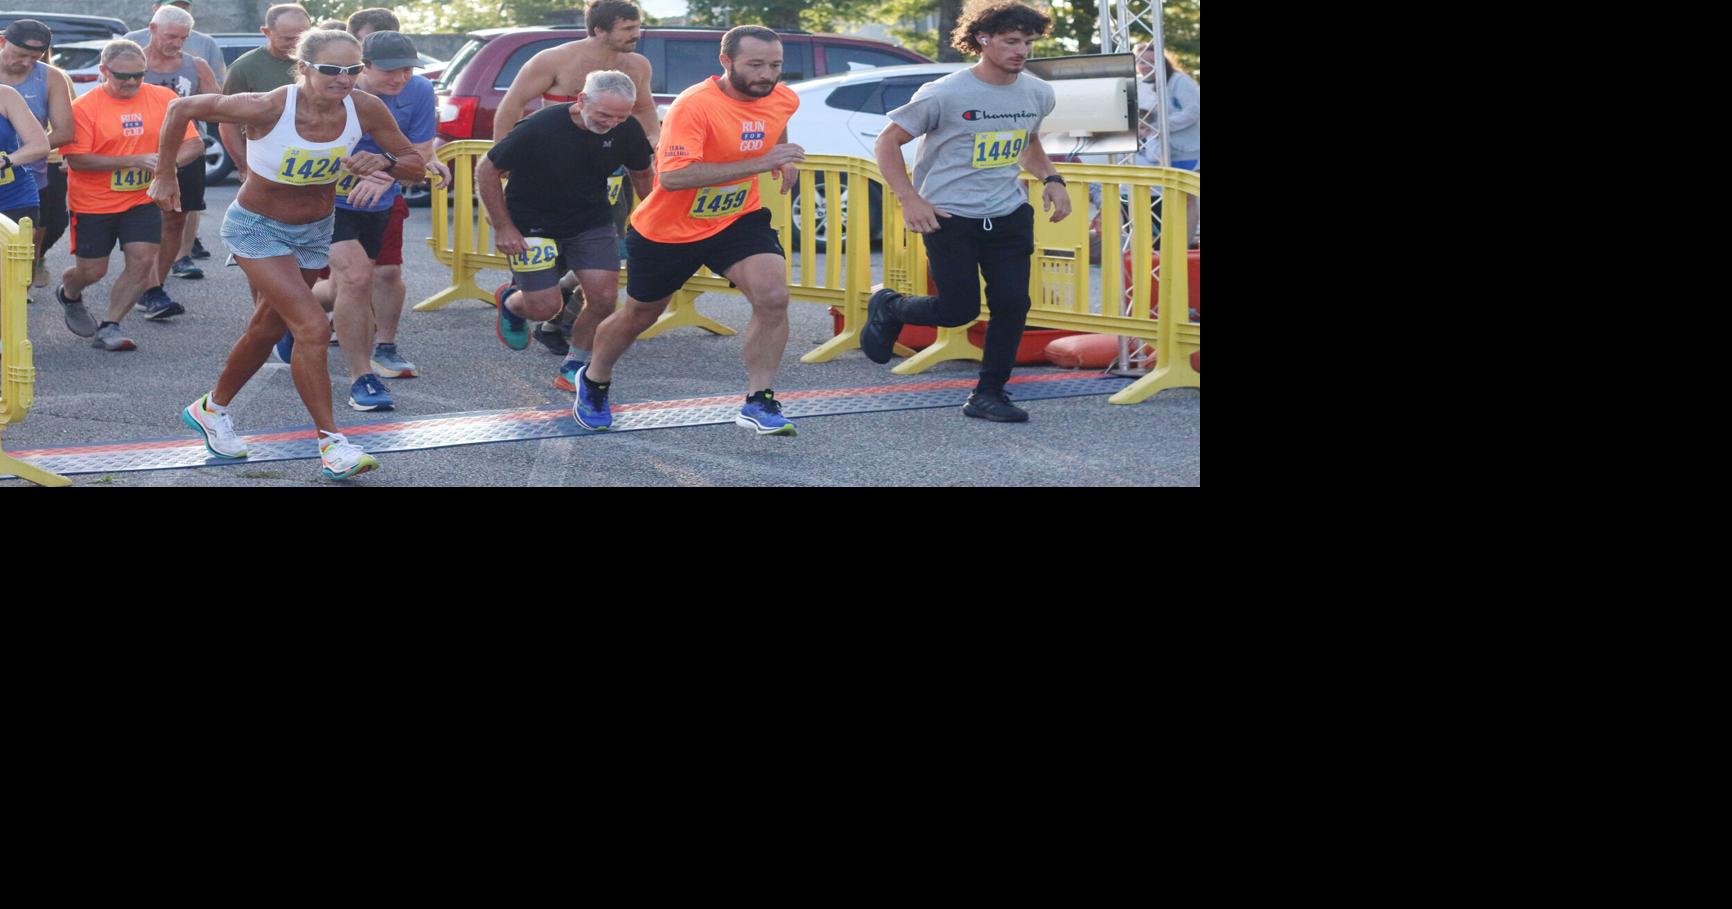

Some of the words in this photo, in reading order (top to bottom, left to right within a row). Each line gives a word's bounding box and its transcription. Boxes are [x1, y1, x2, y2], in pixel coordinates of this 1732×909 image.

[120, 113, 142, 122] RUN
[962, 110, 1037, 122] Champion
[123, 128, 144, 136] GOD
[742, 121, 764, 132] RUN
[740, 140, 763, 151] GOD
[976, 138, 1022, 162] 1449
[281, 157, 341, 178] 1424
[693, 190, 748, 213] 1459
